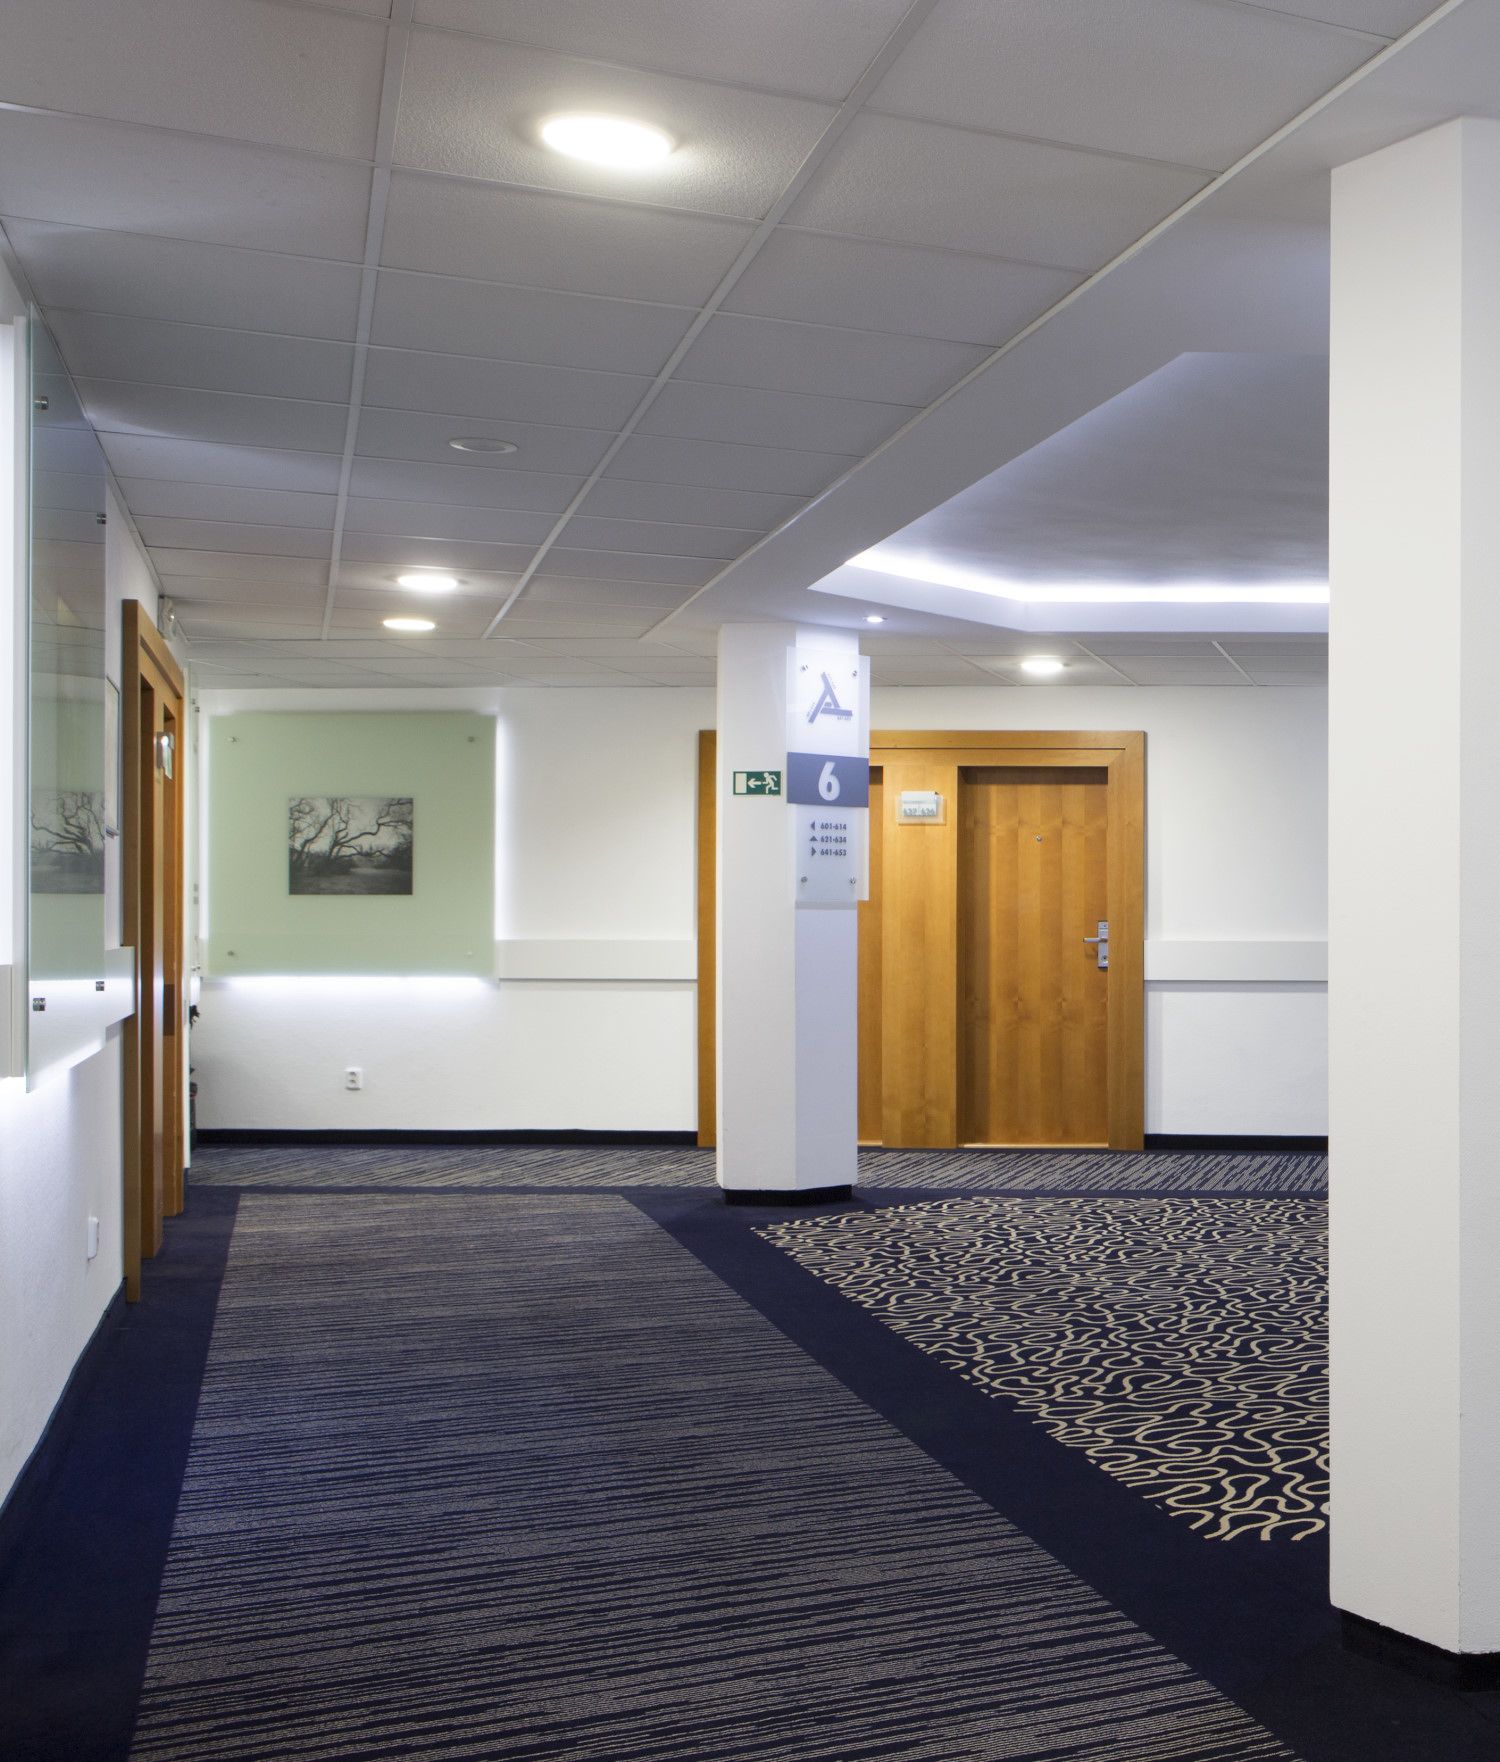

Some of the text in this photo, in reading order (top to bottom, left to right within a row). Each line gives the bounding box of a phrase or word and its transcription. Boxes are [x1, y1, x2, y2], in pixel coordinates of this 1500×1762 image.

[818, 761, 841, 802] 6
[820, 822, 847, 831] 601-614
[820, 835, 847, 844] 621-634
[820, 848, 847, 857] 641-653
